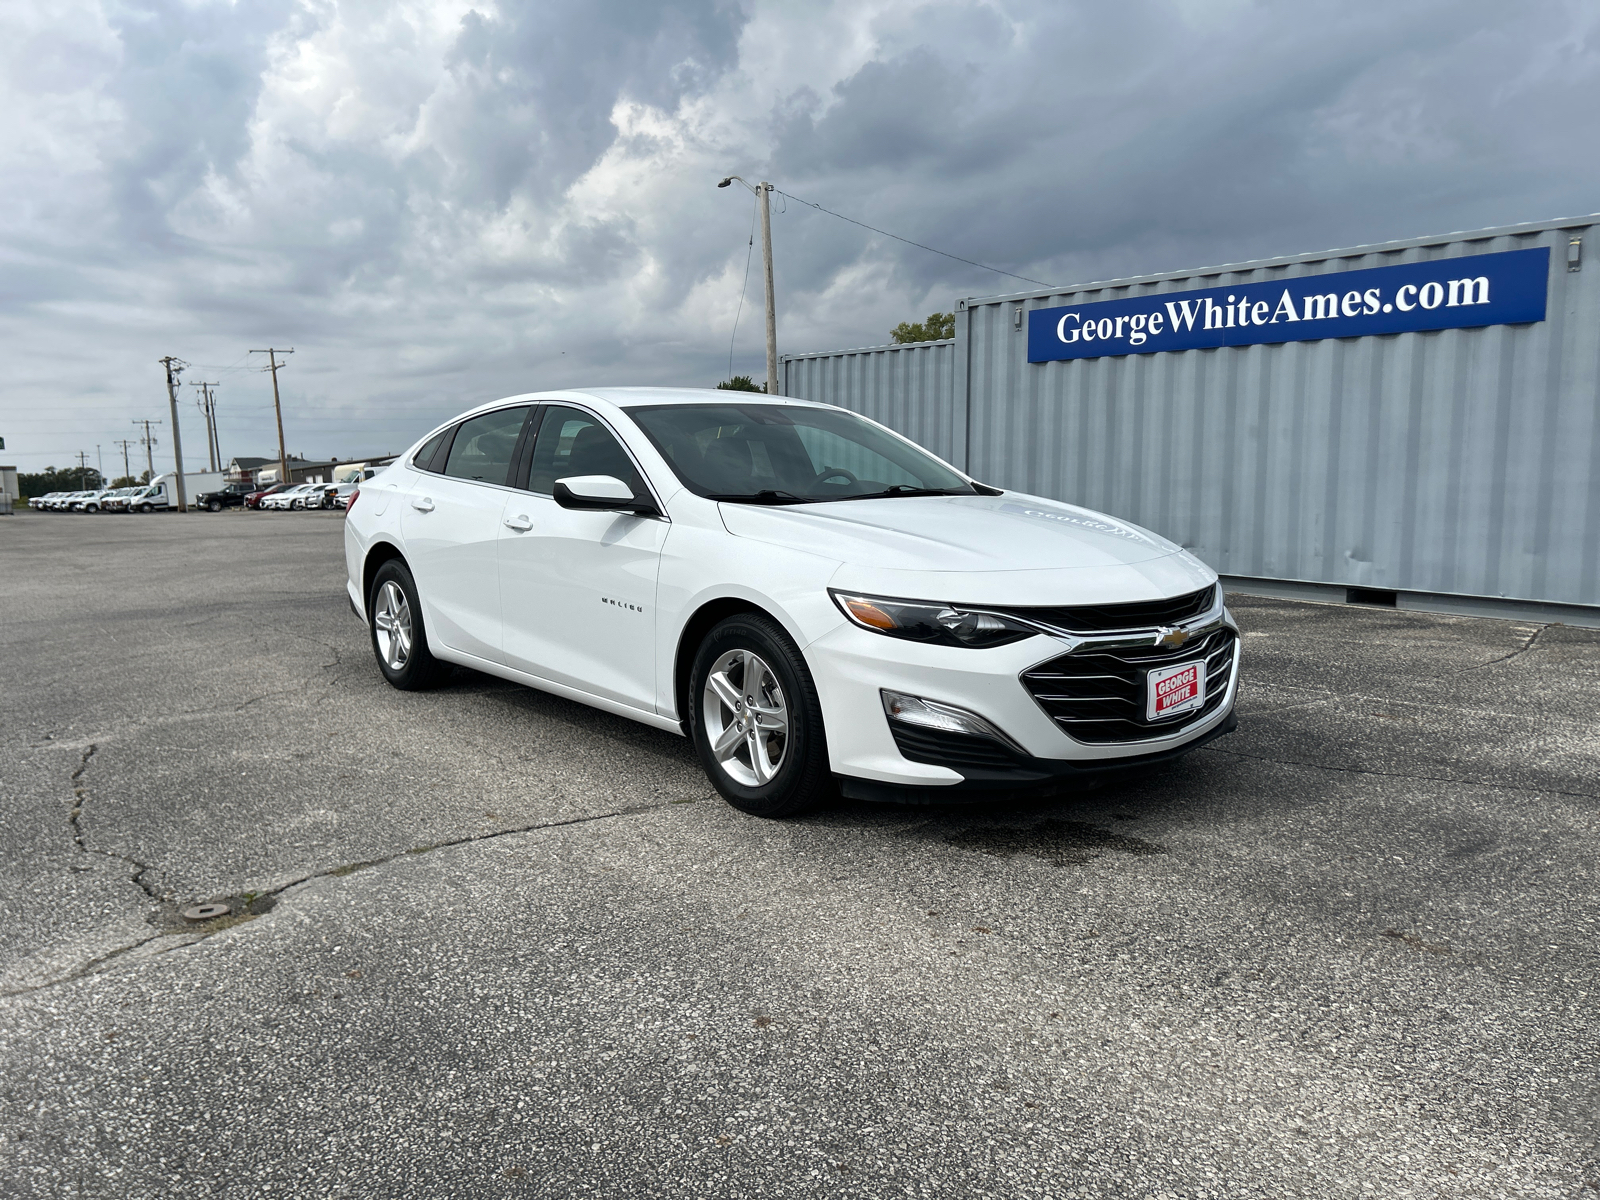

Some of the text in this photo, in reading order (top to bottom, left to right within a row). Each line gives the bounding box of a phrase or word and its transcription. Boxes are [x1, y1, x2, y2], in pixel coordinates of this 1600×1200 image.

[1056, 276, 1490, 345] GeorgeWhiteAmes.com
[1158, 669, 1195, 695] GEORGE
[1162, 686, 1191, 708] WHITE
